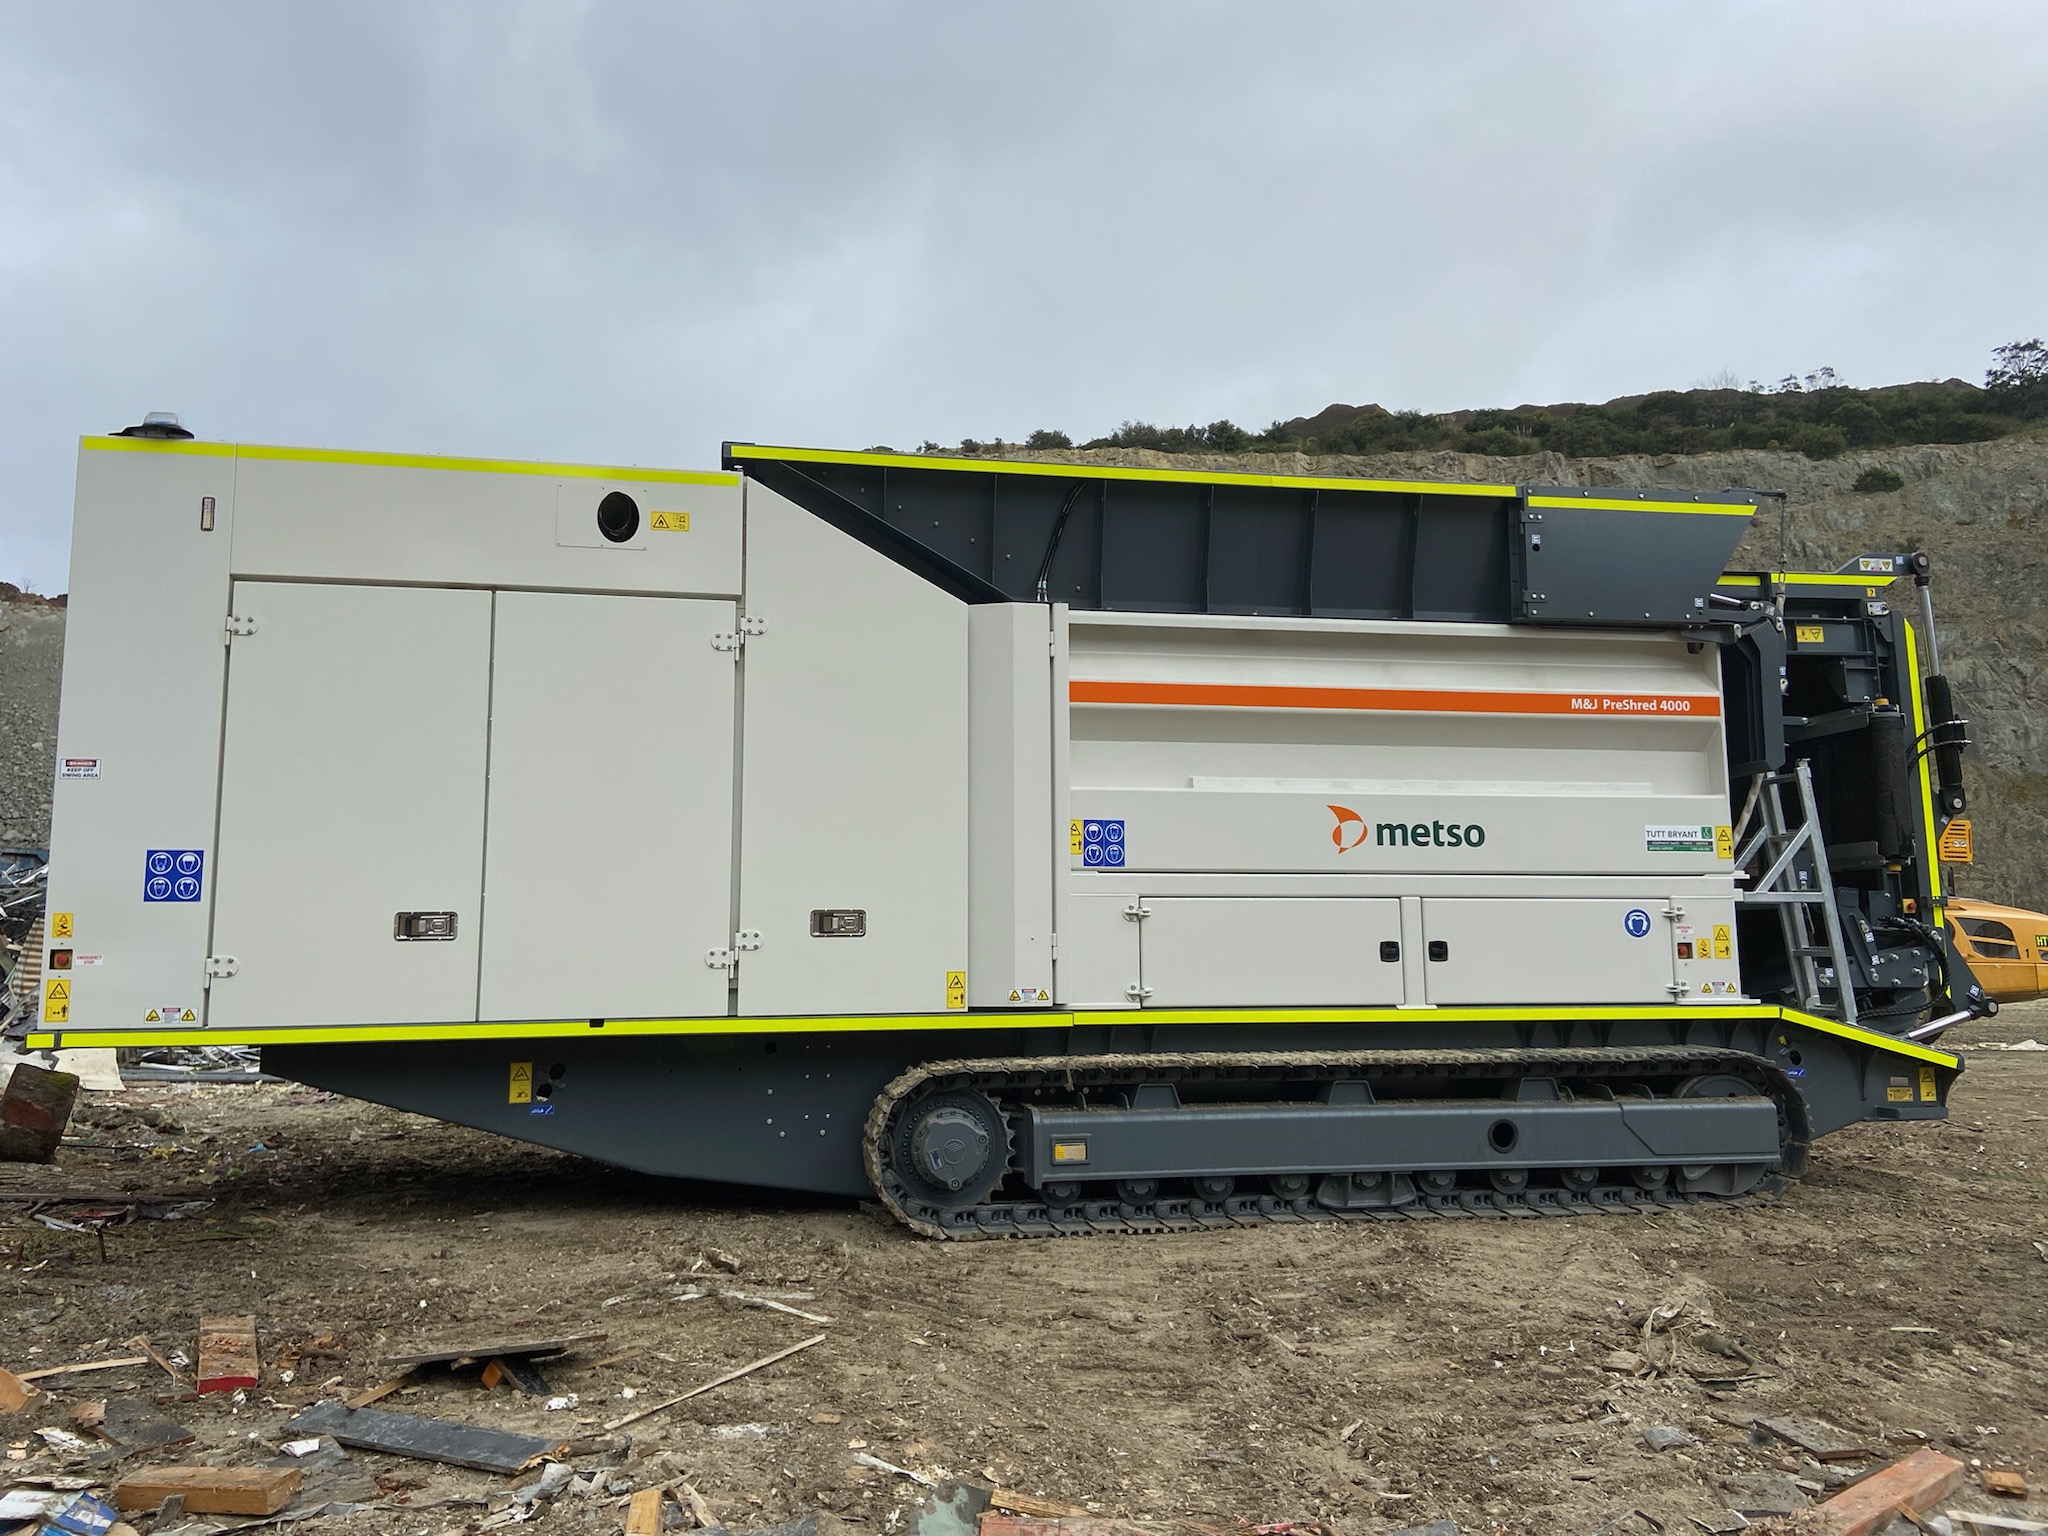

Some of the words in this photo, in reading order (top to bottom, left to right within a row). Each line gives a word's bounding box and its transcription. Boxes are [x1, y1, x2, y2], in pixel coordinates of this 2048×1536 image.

[1571, 698, 1598, 710] M&J
[1603, 699, 1657, 711] PreShred
[1660, 700, 1690, 712] 4000
[1376, 820, 1485, 848] metso
[1646, 830, 1665, 838] TUTT
[1668, 830, 1698, 838] BRYANT
[2025, 948, 2030, 959] 1
